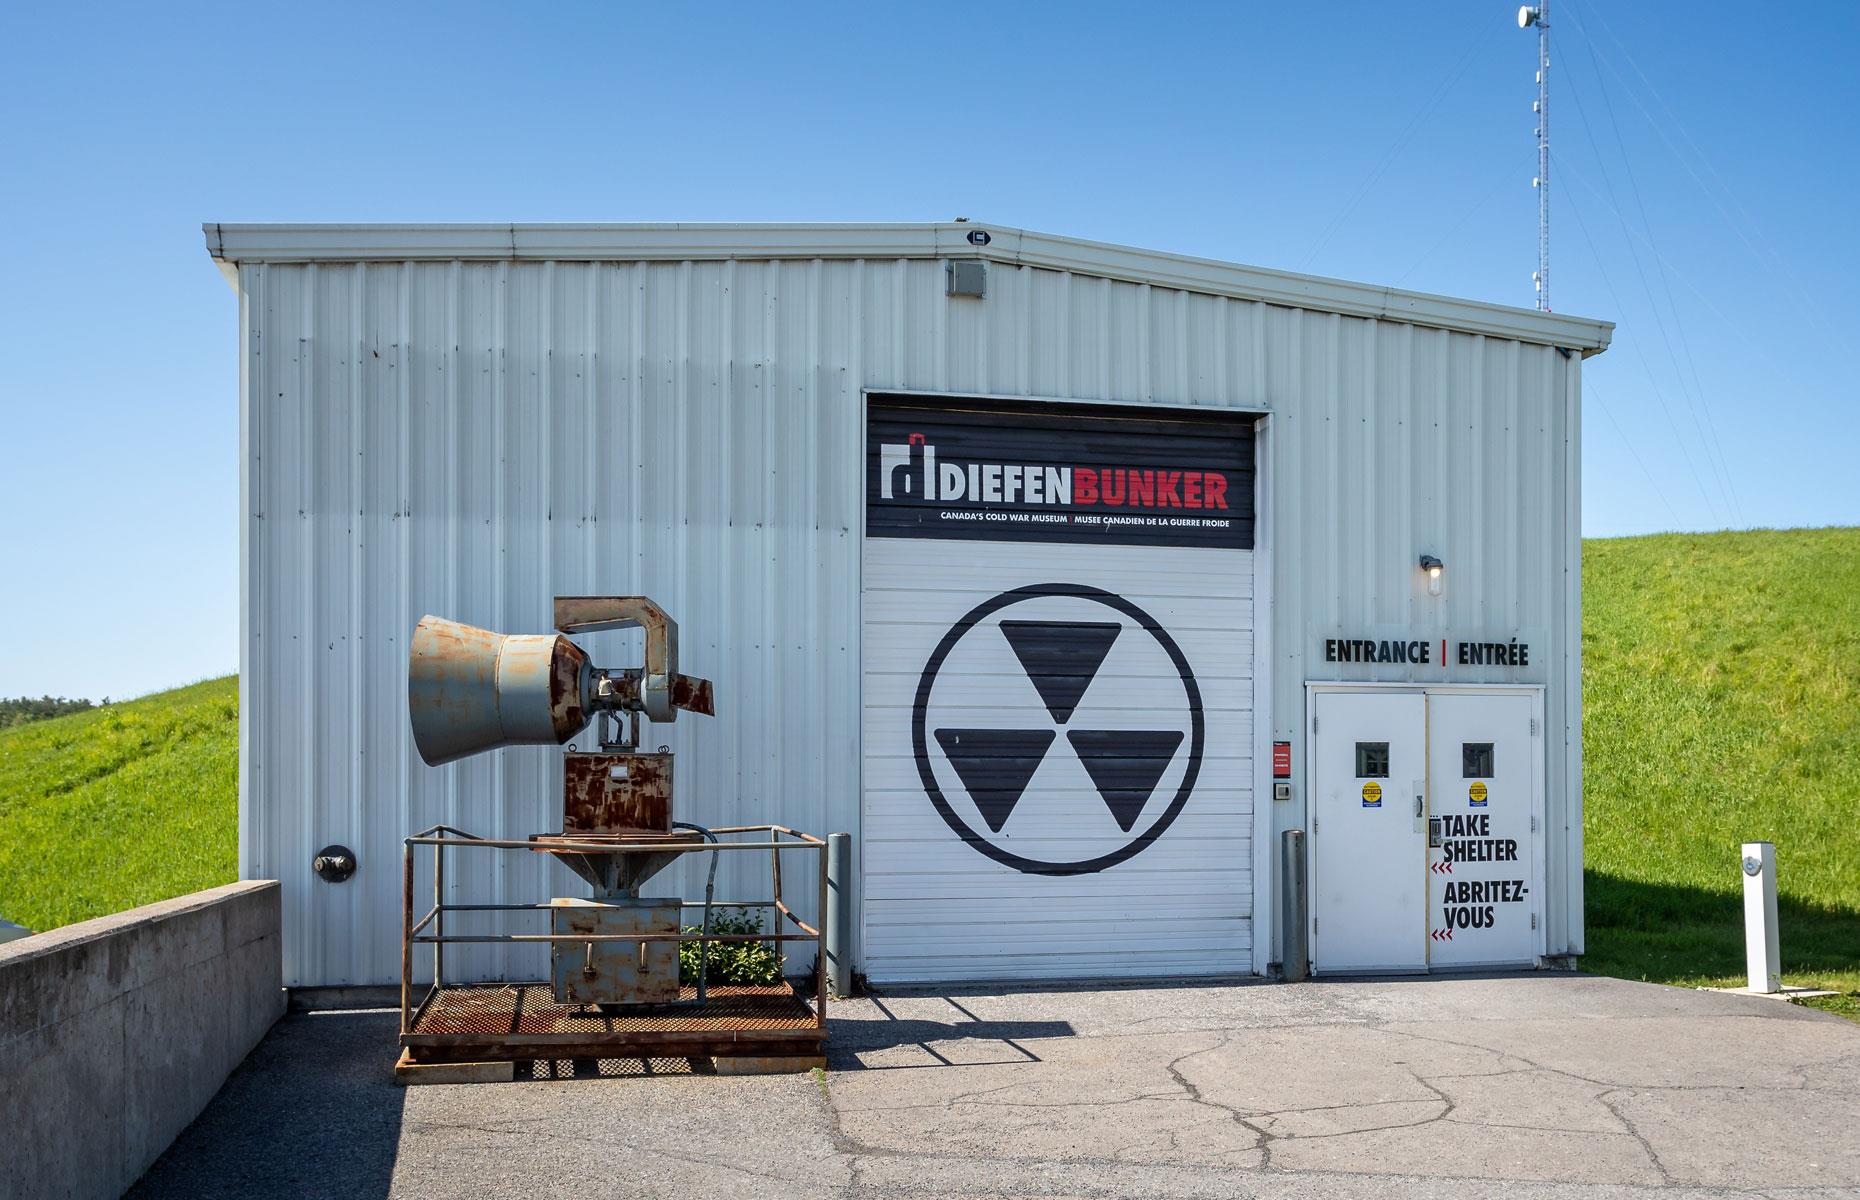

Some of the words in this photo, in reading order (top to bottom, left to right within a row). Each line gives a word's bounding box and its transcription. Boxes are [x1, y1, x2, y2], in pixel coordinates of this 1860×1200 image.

[940, 511, 984, 520] CANADA'S
[985, 513, 1008, 521] COLD
[1009, 514, 1030, 522] WAR
[1031, 515, 1068, 523] MUSEUM
[1102, 516, 1145, 525] CANADIEN
[1146, 518, 1157, 526] DE
[1158, 518, 1169, 526] LA
[1170, 519, 1201, 527] GUERRE
[1325, 639, 1430, 664] ENTRANCE
[1458, 637, 1529, 666] ENTRÉE
[1442, 814, 1490, 837] TAKE
[1443, 839, 1518, 863] SHELTER
[1443, 880, 1529, 904] ABRITEZ-
[1443, 906, 1495, 930] VOUS
